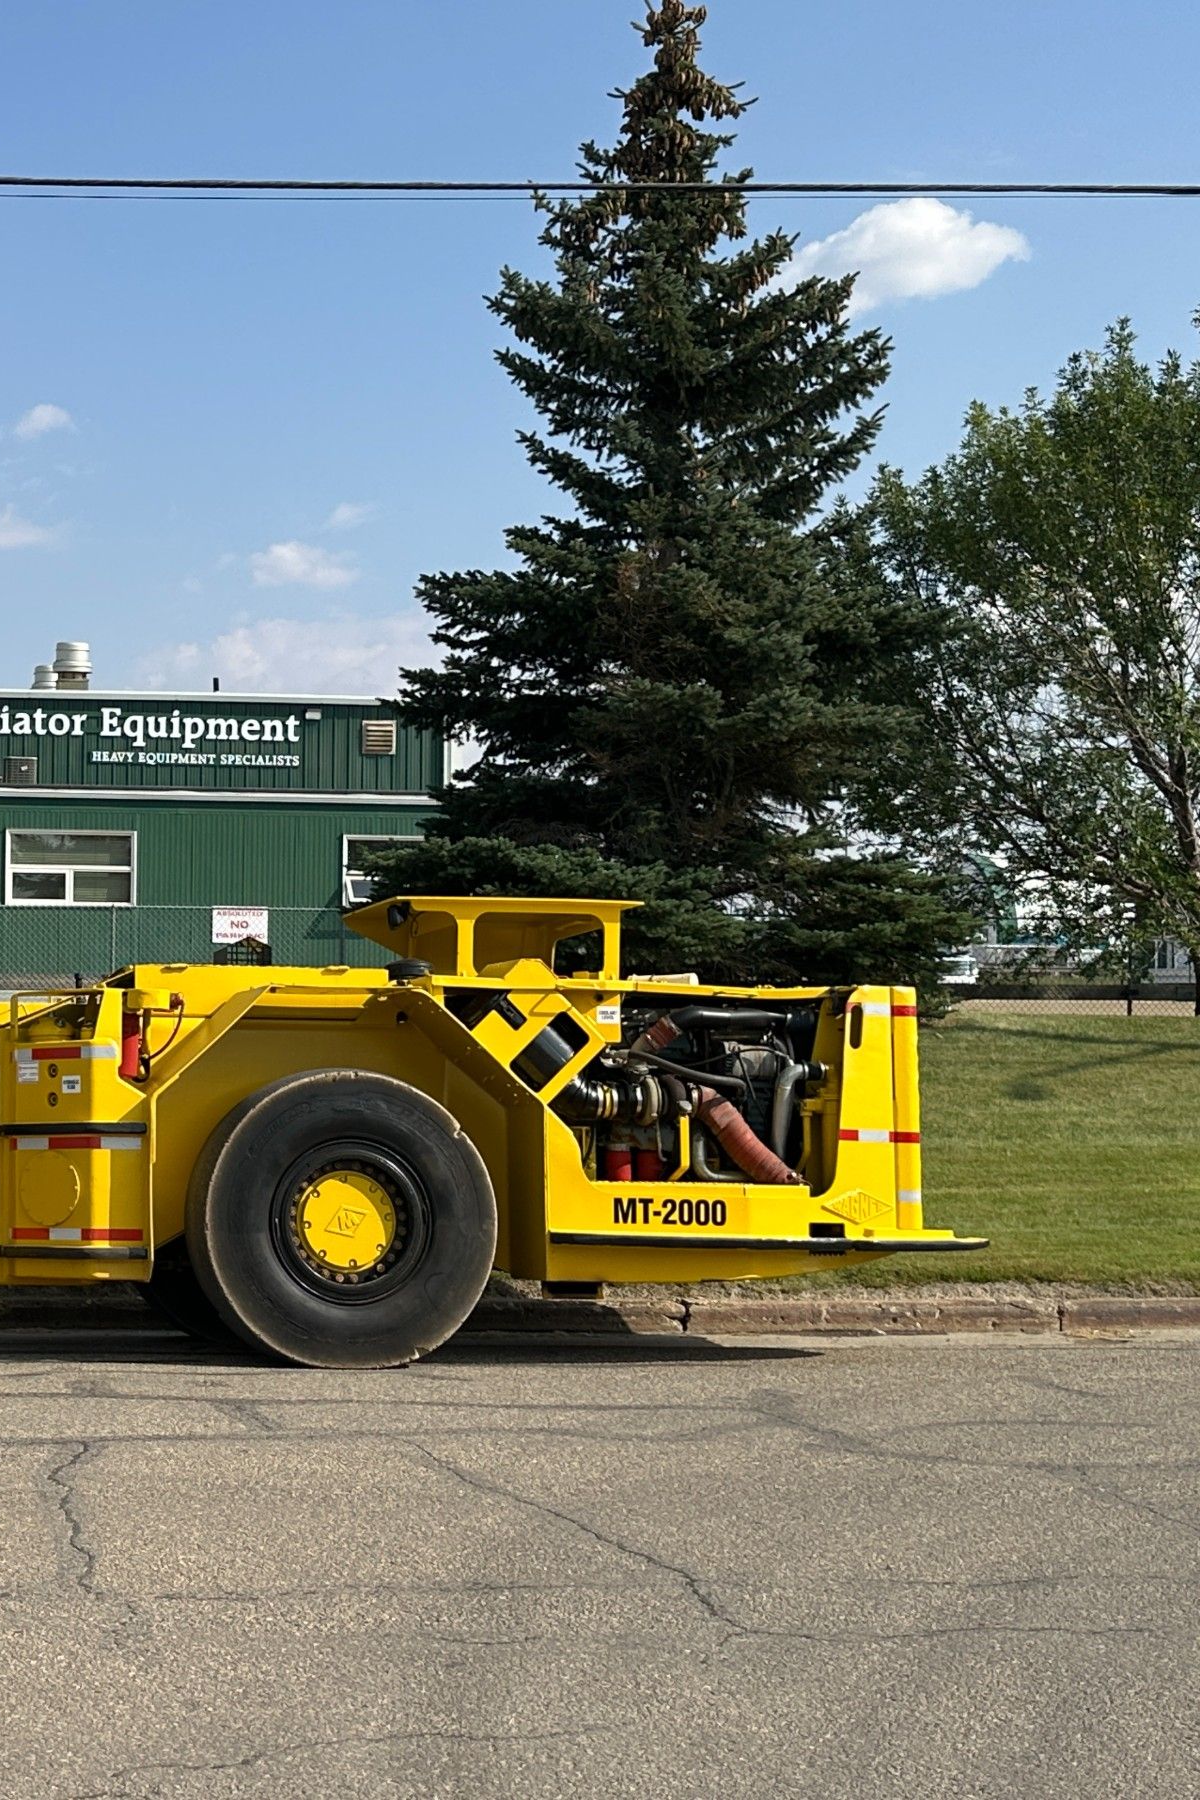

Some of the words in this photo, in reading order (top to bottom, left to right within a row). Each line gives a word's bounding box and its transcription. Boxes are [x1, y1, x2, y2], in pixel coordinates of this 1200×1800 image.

[99, 707, 300, 748] Equipment
[91, 750, 134, 763] HEAVY
[138, 752, 216, 766] EQUIPMENT
[219, 754, 300, 767] SPECIALISTS
[230, 920, 249, 929] NO
[613, 1197, 727, 1226] MT-2000
